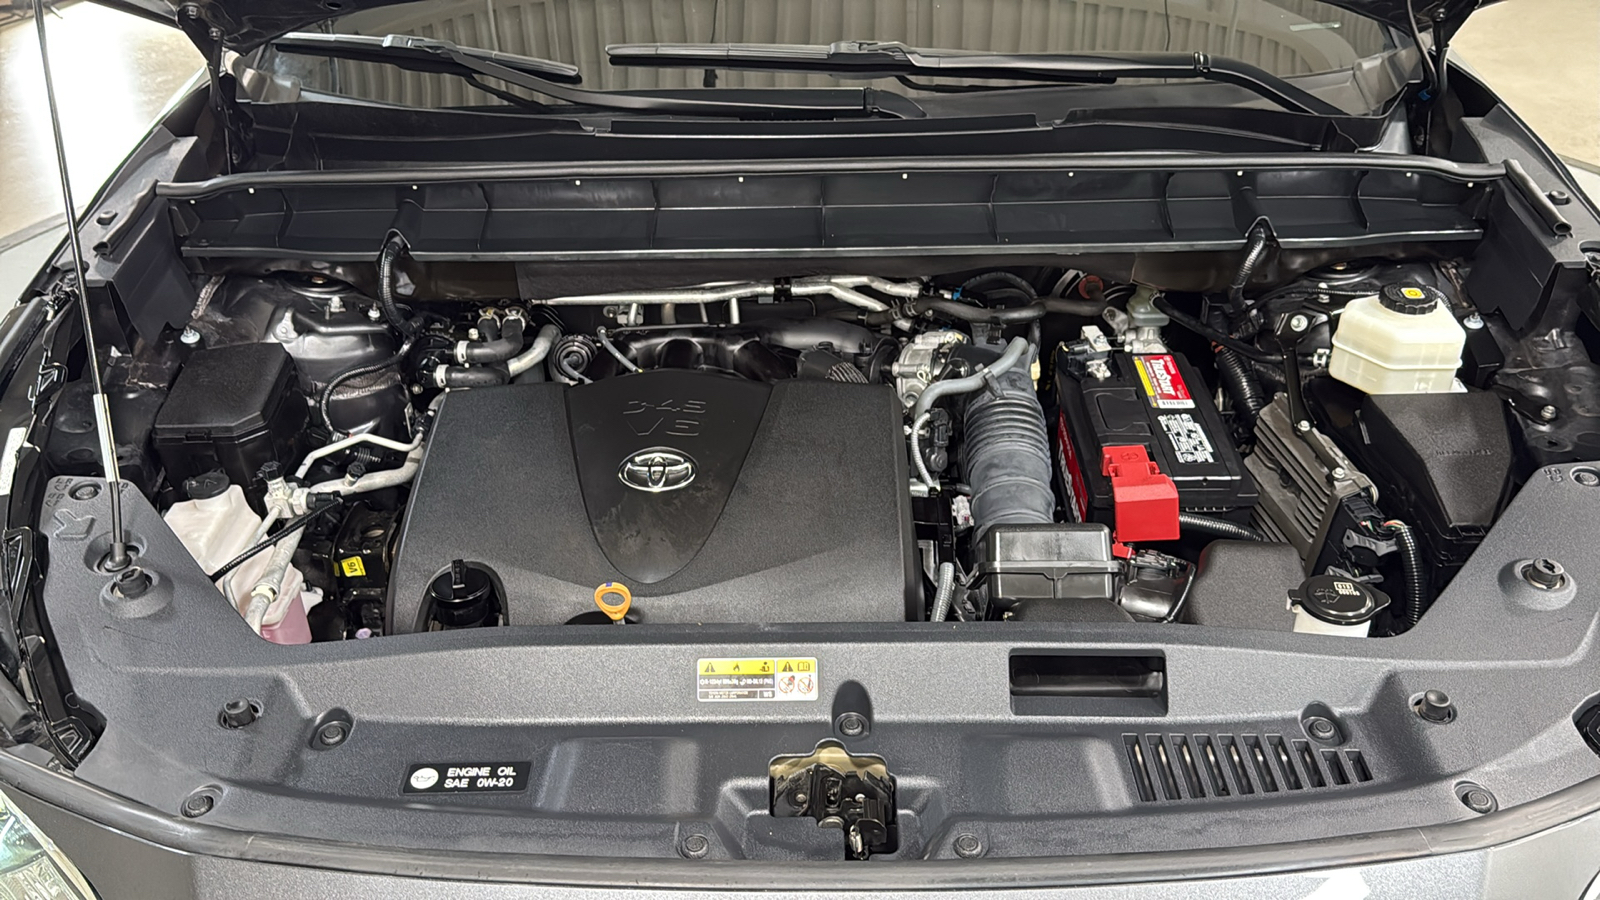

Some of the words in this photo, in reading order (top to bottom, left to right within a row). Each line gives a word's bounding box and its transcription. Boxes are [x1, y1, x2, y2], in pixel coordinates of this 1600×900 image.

[347, 561, 358, 573] V6
[446, 767, 491, 777] ENGINE
[497, 766, 516, 776] OIL
[443, 778, 470, 789] SAE
[476, 777, 514, 788] 0W-20
